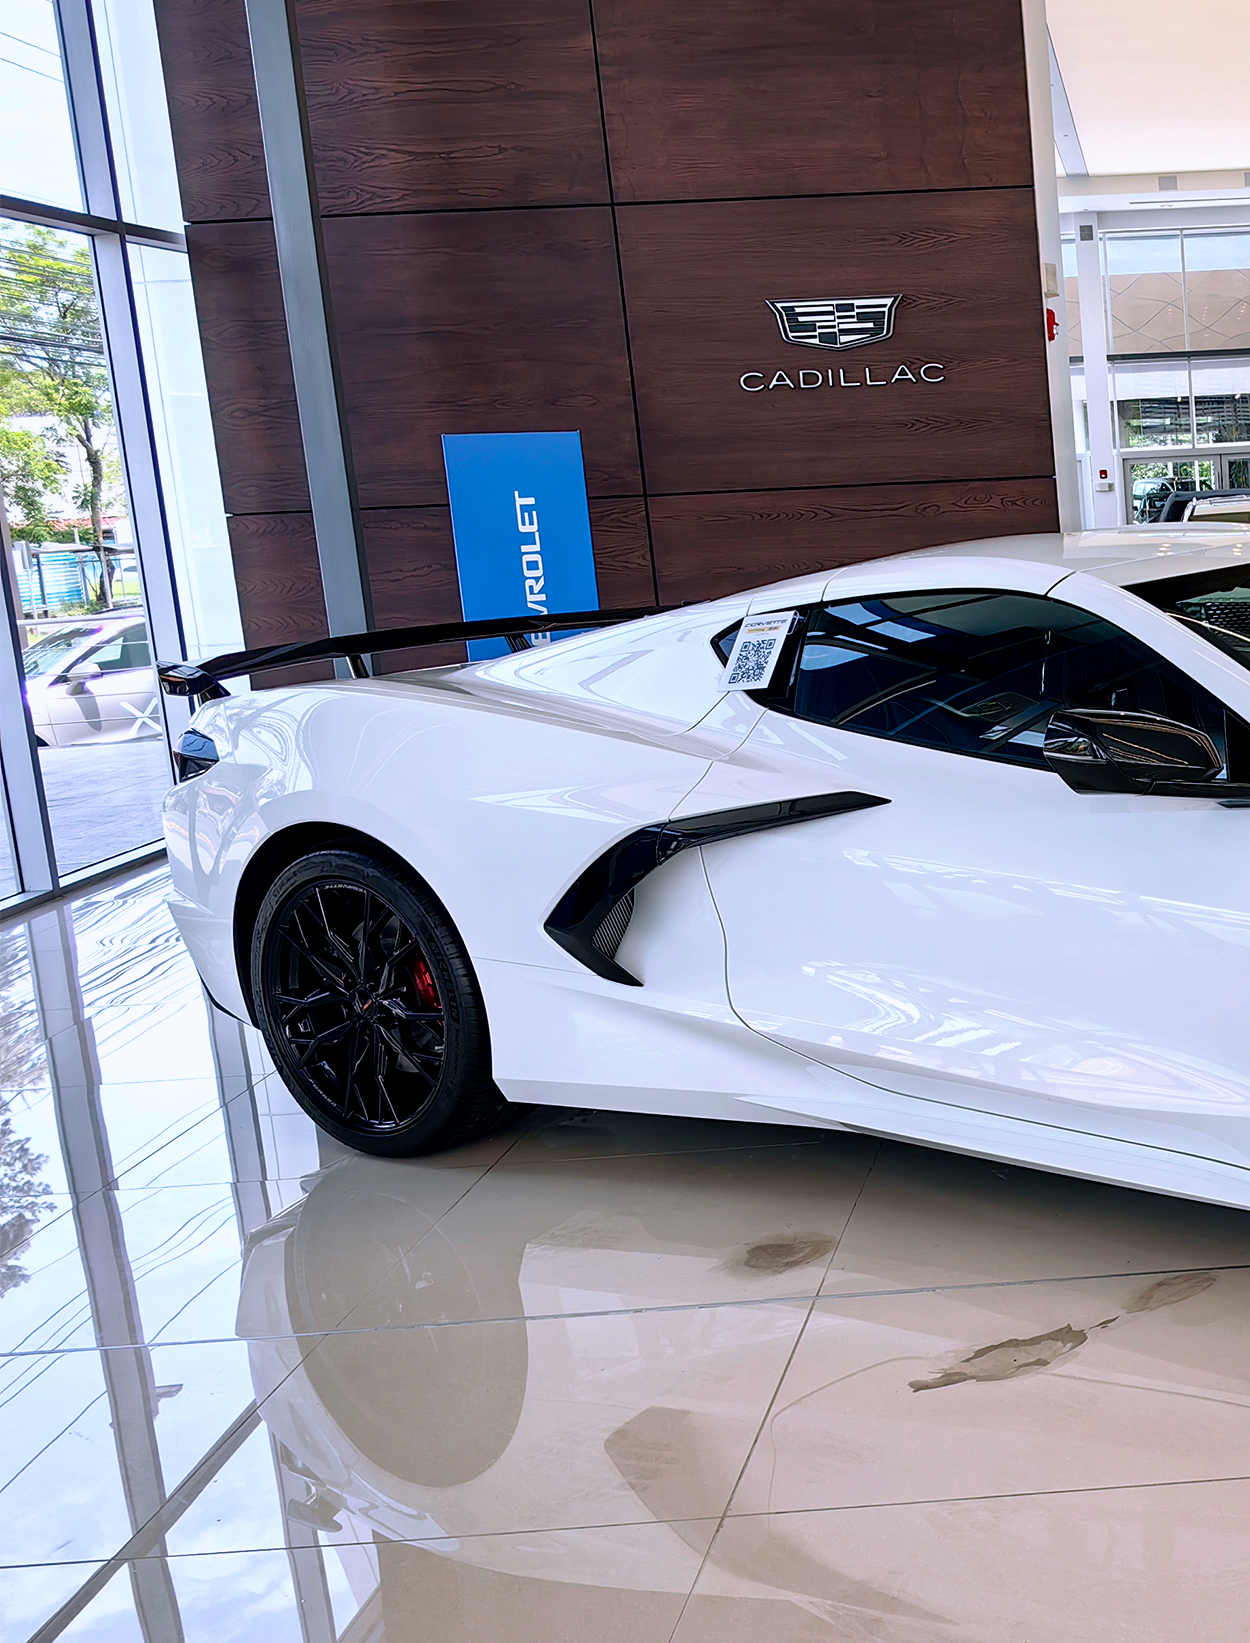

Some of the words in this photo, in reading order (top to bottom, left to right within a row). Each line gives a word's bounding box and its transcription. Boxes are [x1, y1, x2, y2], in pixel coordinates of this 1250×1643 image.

[740, 363, 945, 392] CADILLAC
[514, 491, 551, 648] EVROLET
[745, 619, 788, 627] CORVETTE
